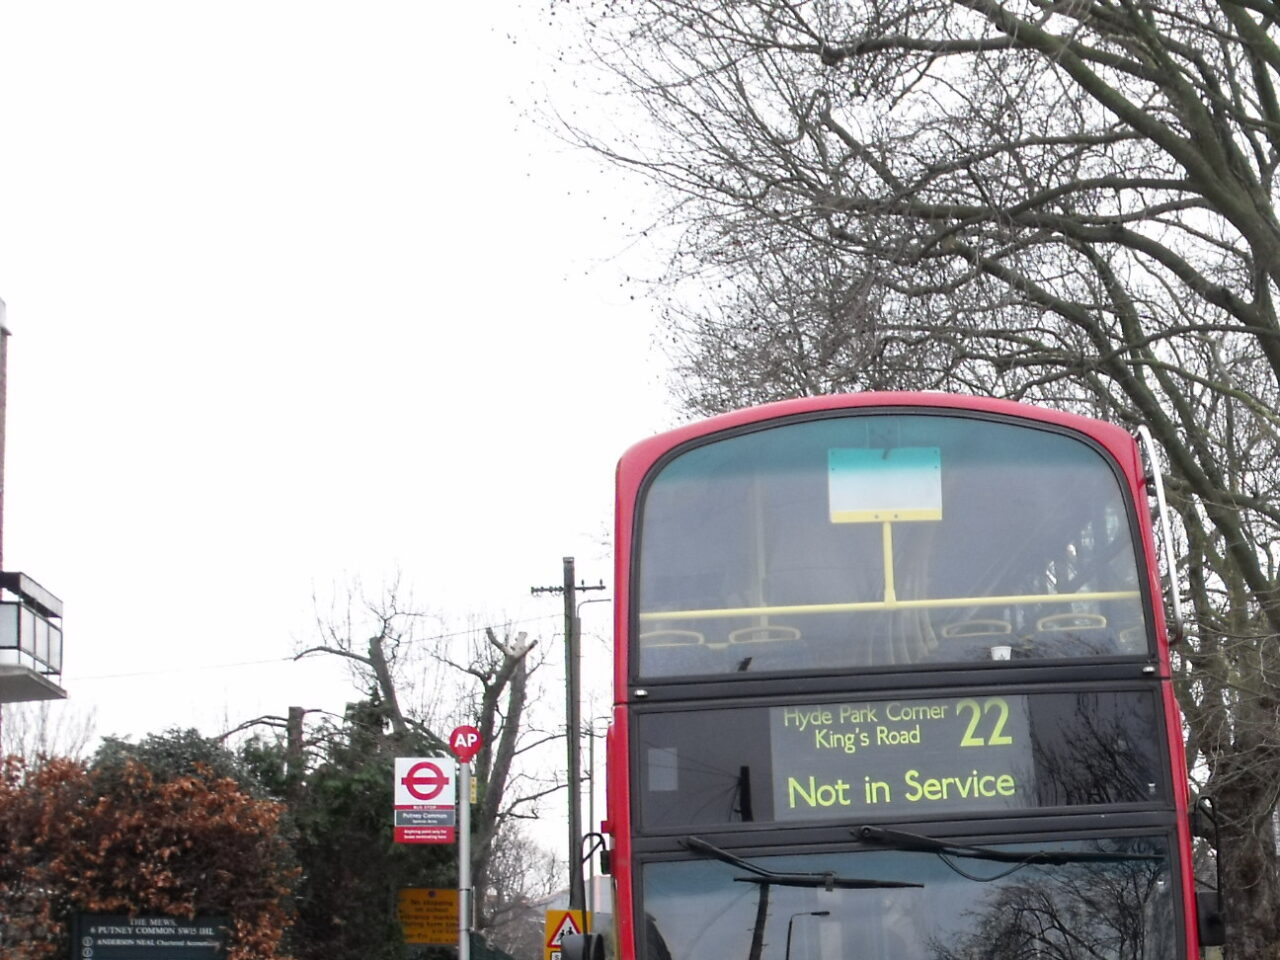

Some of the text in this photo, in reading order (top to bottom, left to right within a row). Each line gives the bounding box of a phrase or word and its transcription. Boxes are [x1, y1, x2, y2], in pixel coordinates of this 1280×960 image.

[783, 698, 1013, 747] Hyde Park Corner 22
[453, 733, 478, 748] AP
[815, 724, 921, 753] King's Road
[787, 769, 1016, 809] Not in Service
[98, 926, 133, 935] PUTNEY
[135, 926, 176, 935] COMMON
[178, 927, 197, 935] SW15
[130, 918, 147, 926] THE
